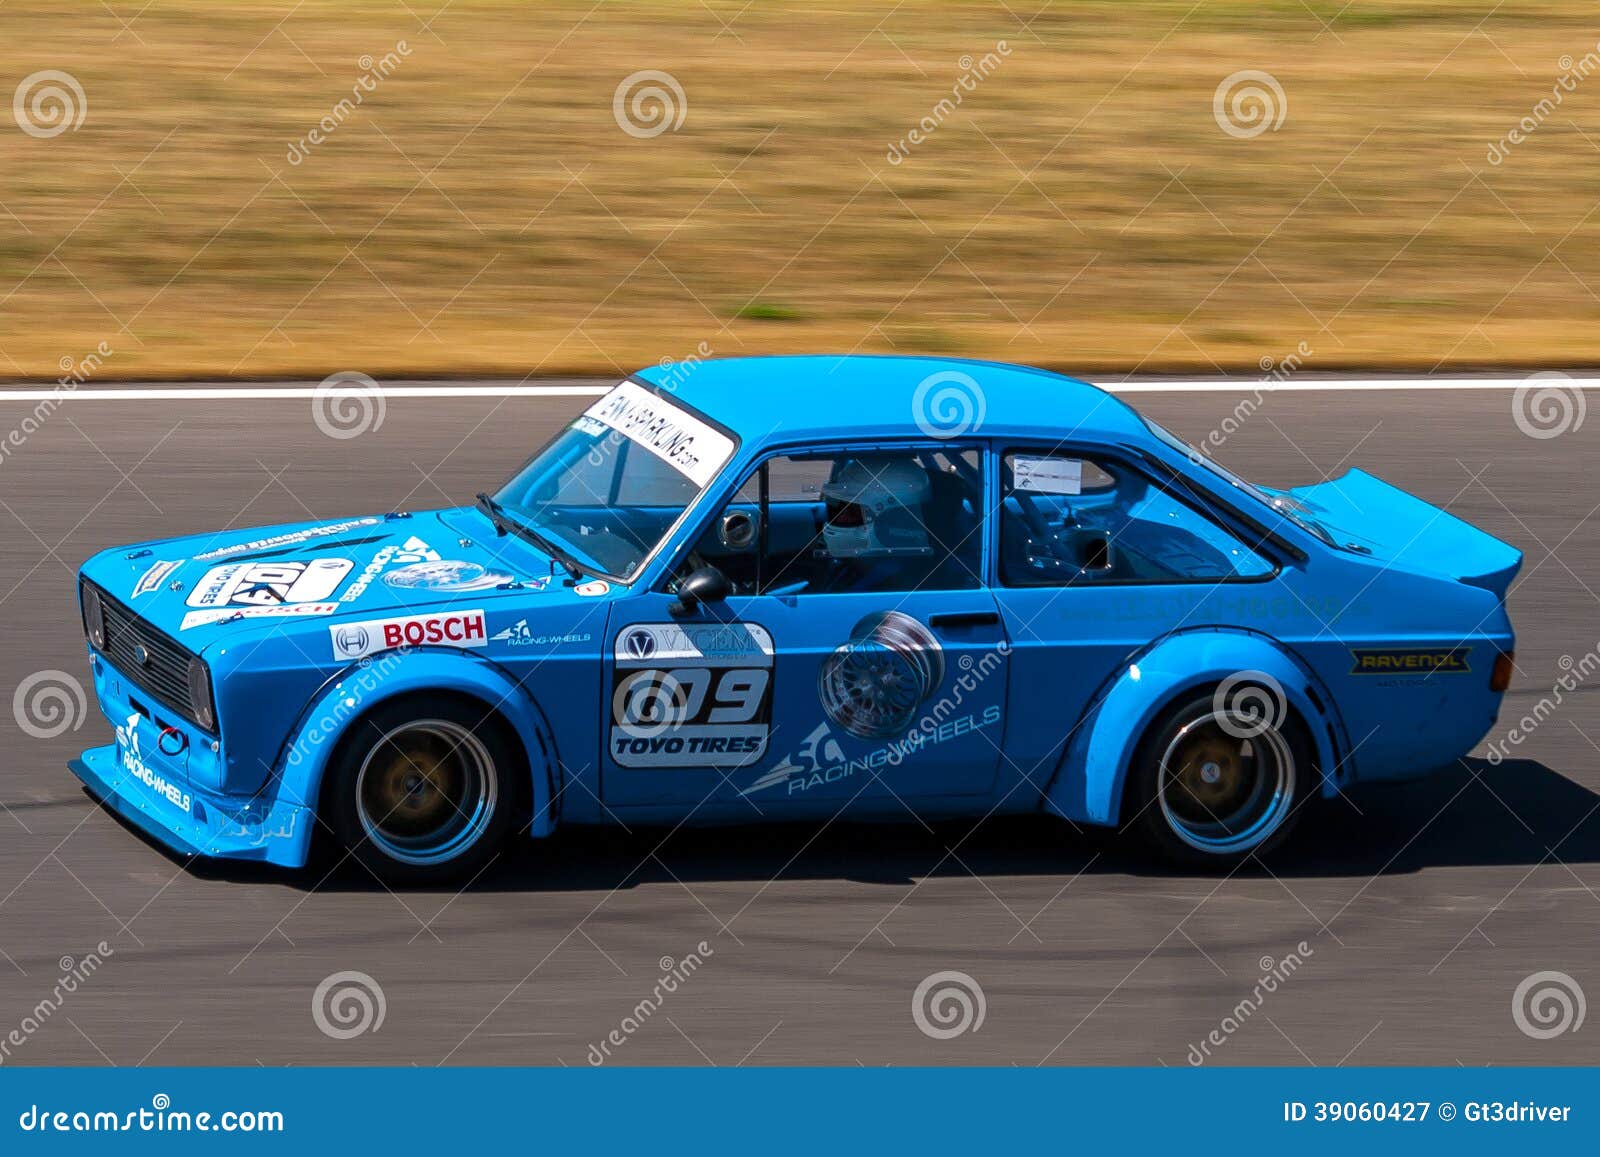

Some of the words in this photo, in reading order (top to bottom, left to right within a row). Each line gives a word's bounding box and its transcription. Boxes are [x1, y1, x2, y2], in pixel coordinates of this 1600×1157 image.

[382, 615, 485, 648] BOSCH
[507, 633, 591, 647] RACING-WHEELS
[1362, 654, 1460, 667] RAVENOL
[621, 668, 770, 724] 109
[616, 737, 685, 754] TOYO
[688, 736, 762, 753] TIRES
[788, 704, 1000, 796] RACING-WHEELS
[123, 750, 191, 813] RACING-WHEELS
